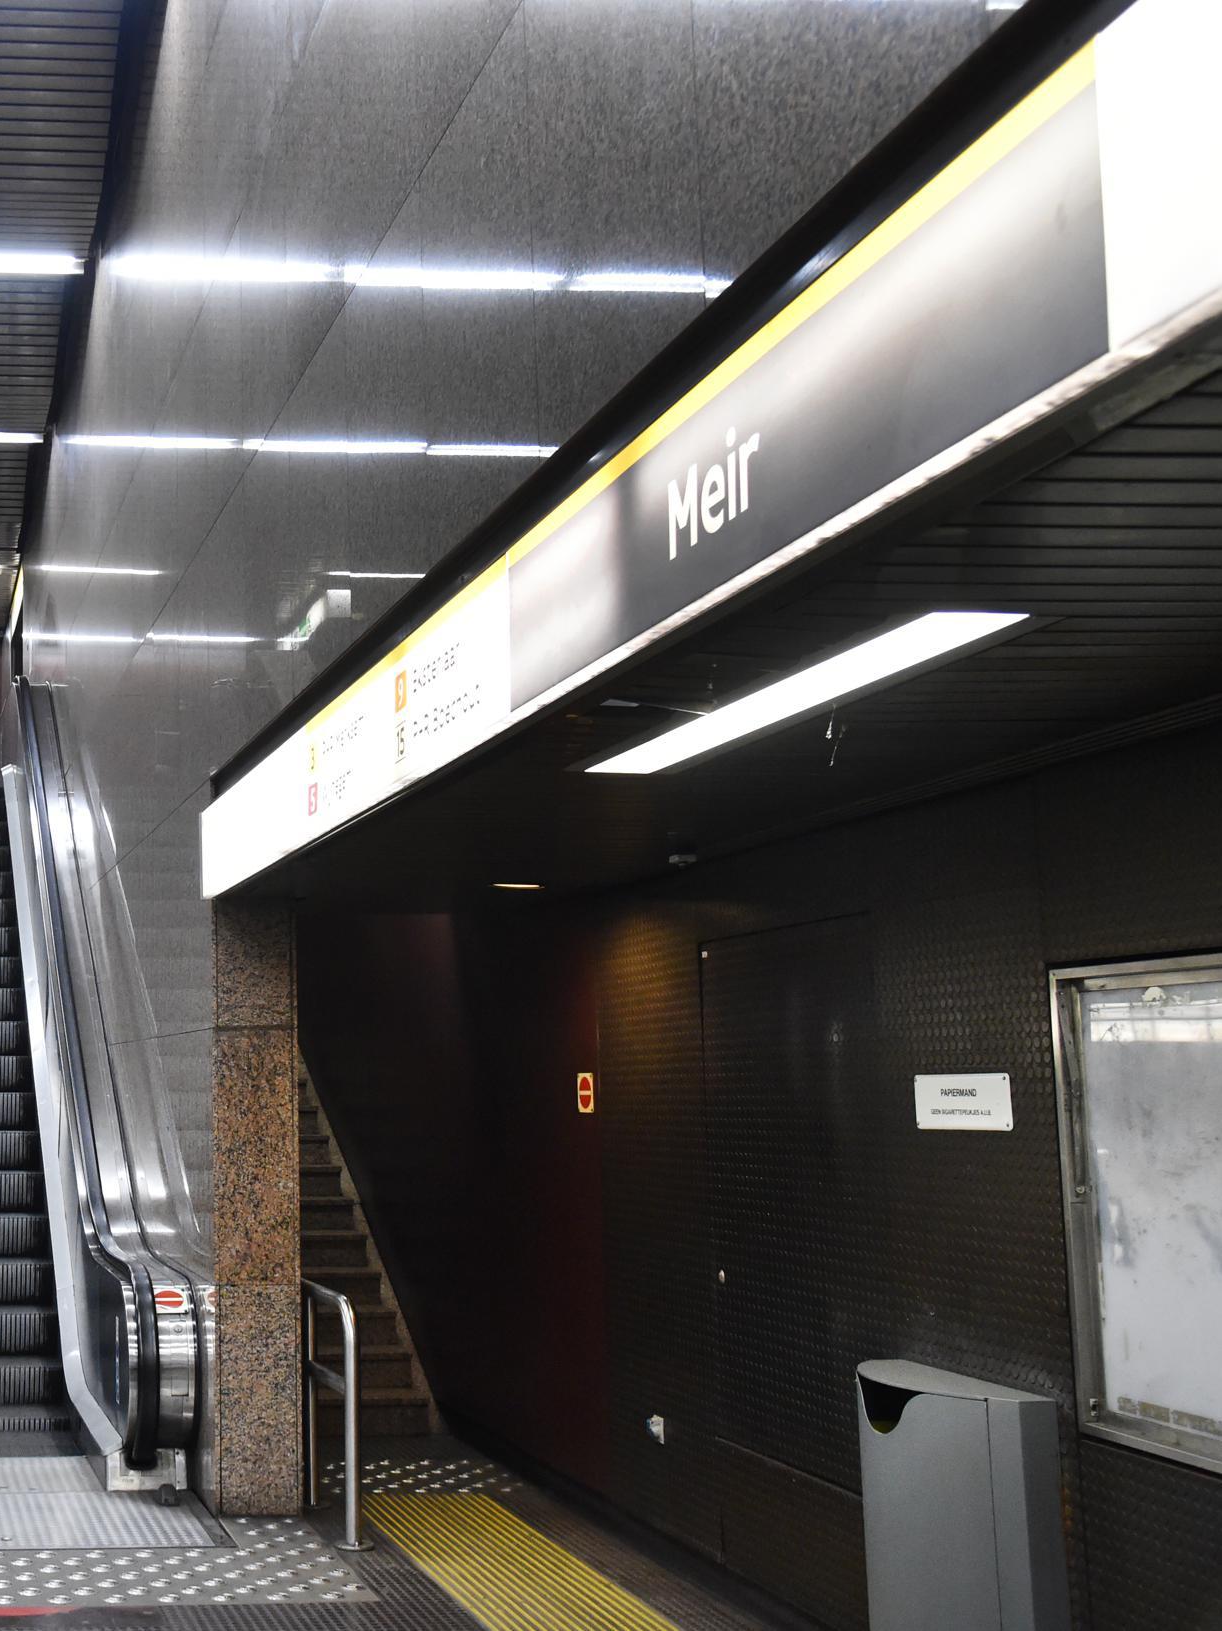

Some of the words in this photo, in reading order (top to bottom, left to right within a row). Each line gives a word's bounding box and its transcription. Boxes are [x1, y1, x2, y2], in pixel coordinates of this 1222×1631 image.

[668, 426, 760, 561] Meir
[397, 726, 405, 757] 15
[940, 1088, 977, 1097] PAPIERMAND
